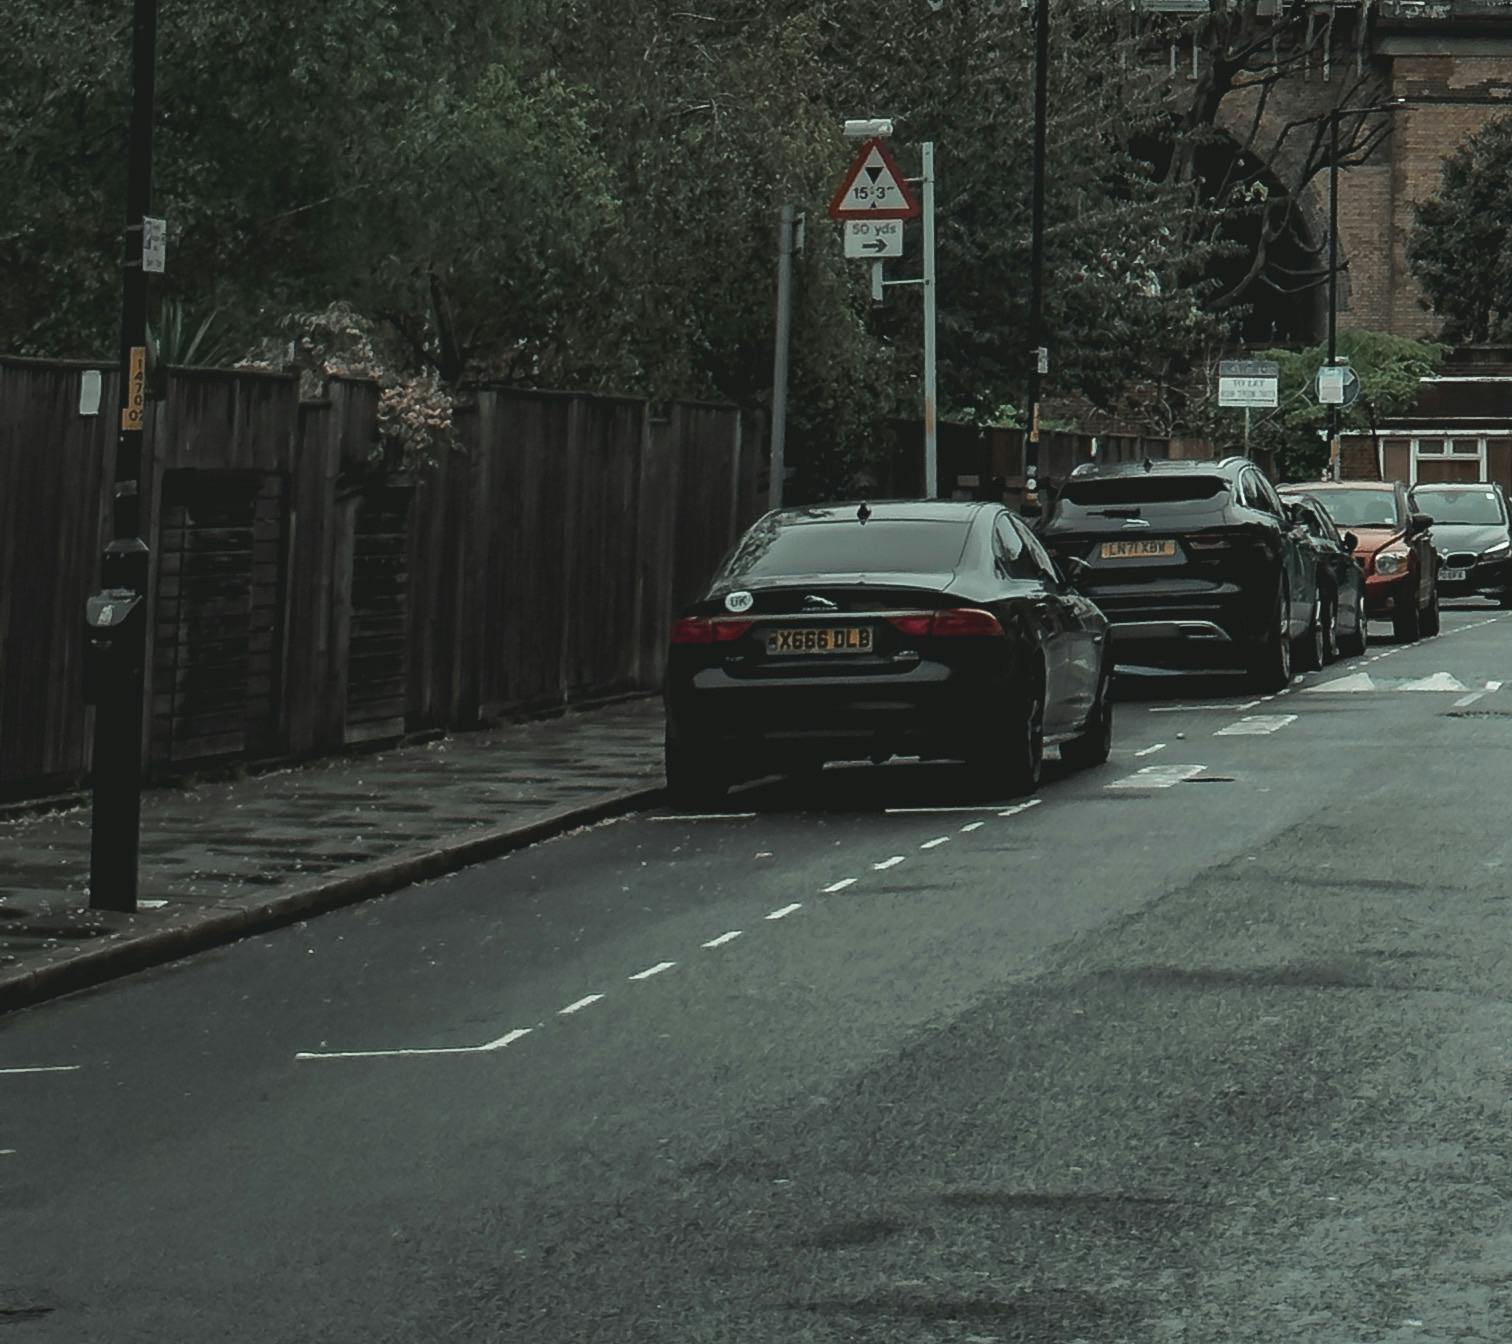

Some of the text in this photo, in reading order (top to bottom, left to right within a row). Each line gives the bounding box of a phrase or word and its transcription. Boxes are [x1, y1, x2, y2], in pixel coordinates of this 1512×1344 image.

[852, 223, 896, 236] 50 yds
[730, 596, 748, 607] UK
[779, 628, 871, 651] X666 DLB
